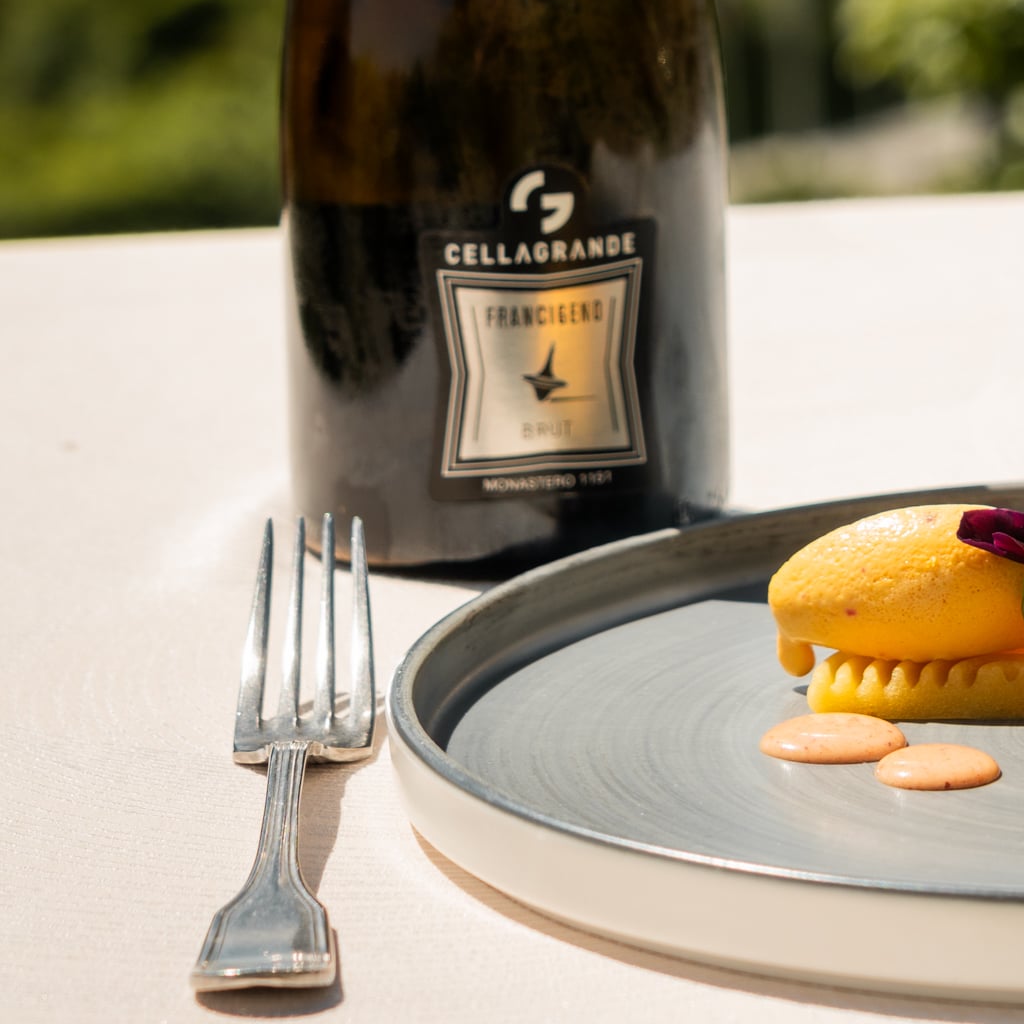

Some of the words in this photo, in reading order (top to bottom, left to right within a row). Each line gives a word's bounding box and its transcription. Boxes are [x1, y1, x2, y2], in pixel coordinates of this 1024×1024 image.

[444, 232, 636, 266] CELLAGRANDE
[485, 298, 603, 327] FRANCIGENO
[522, 419, 572, 441] BRUT
[482, 473, 576, 492] MONASTERO
